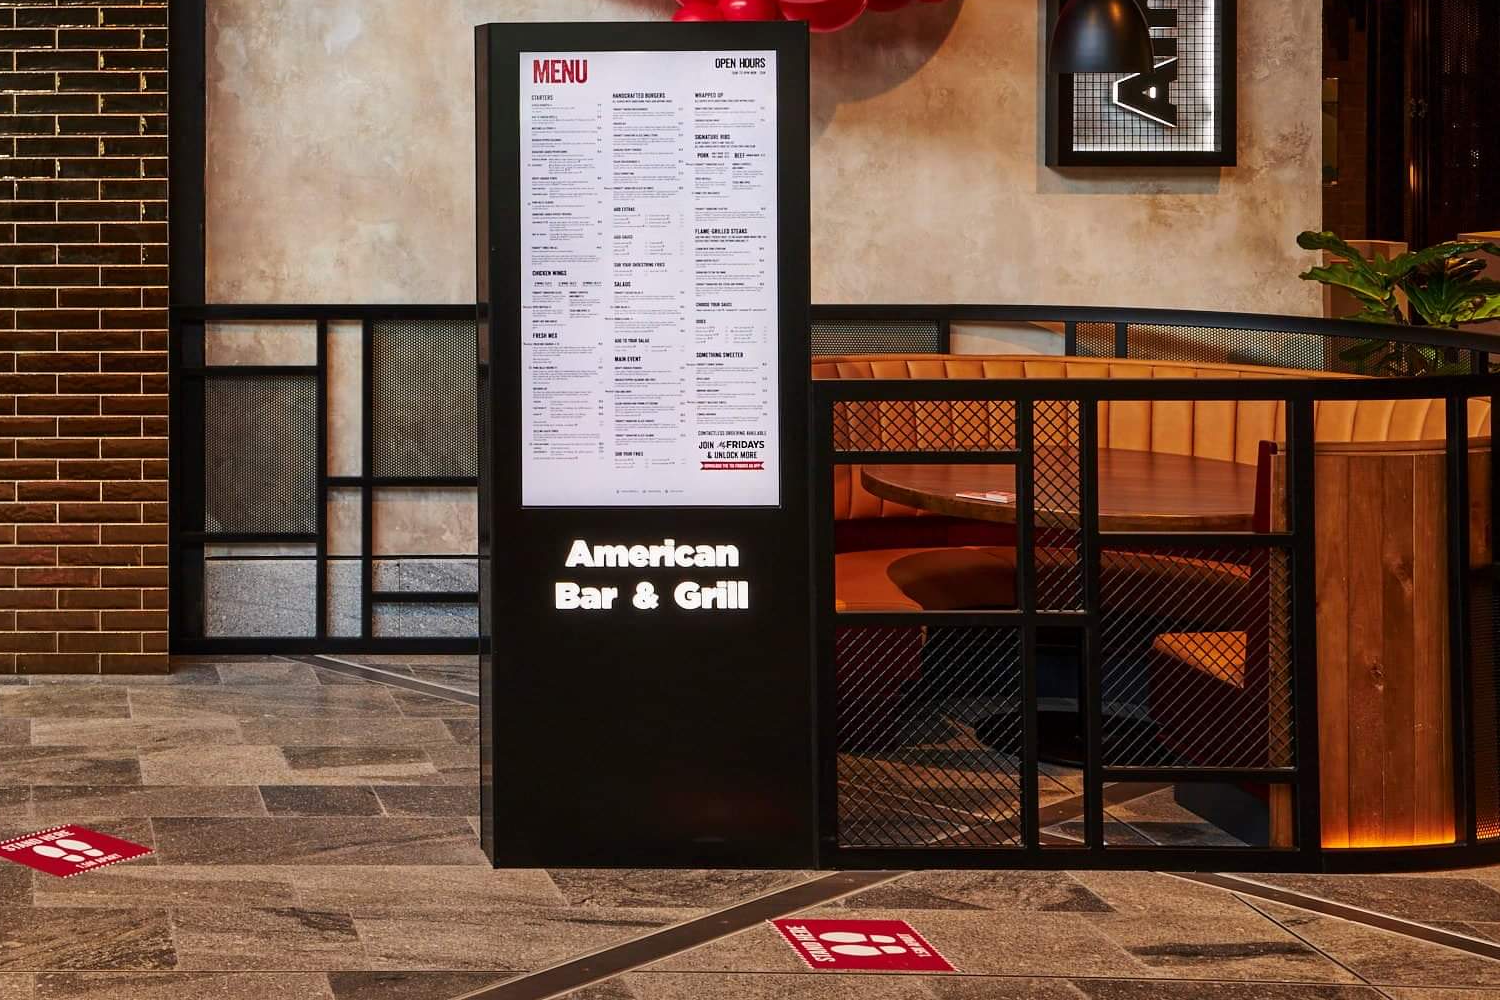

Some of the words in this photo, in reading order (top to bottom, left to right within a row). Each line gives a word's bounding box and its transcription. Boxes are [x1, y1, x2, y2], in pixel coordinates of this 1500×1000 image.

[533, 59, 588, 84] MENU
[715, 58, 736, 68] OPEN
[739, 57, 766, 68] HOURS
[698, 440, 715, 449] JOIN
[726, 440, 765, 449] FRIDAYS
[707, 451, 713, 459] &
[714, 451, 739, 459] UNLOCK
[740, 451, 757, 459] MORE
[564, 538, 740, 567] American
[555, 581, 618, 609] Bar
[632, 581, 660, 609] &
[674, 580, 749, 609] Grill
[1, 838, 44, 852] STAND
[38, 829, 75, 843] HERE
[785, 925, 819, 942] HERE
[801, 941, 837, 963] STAND
